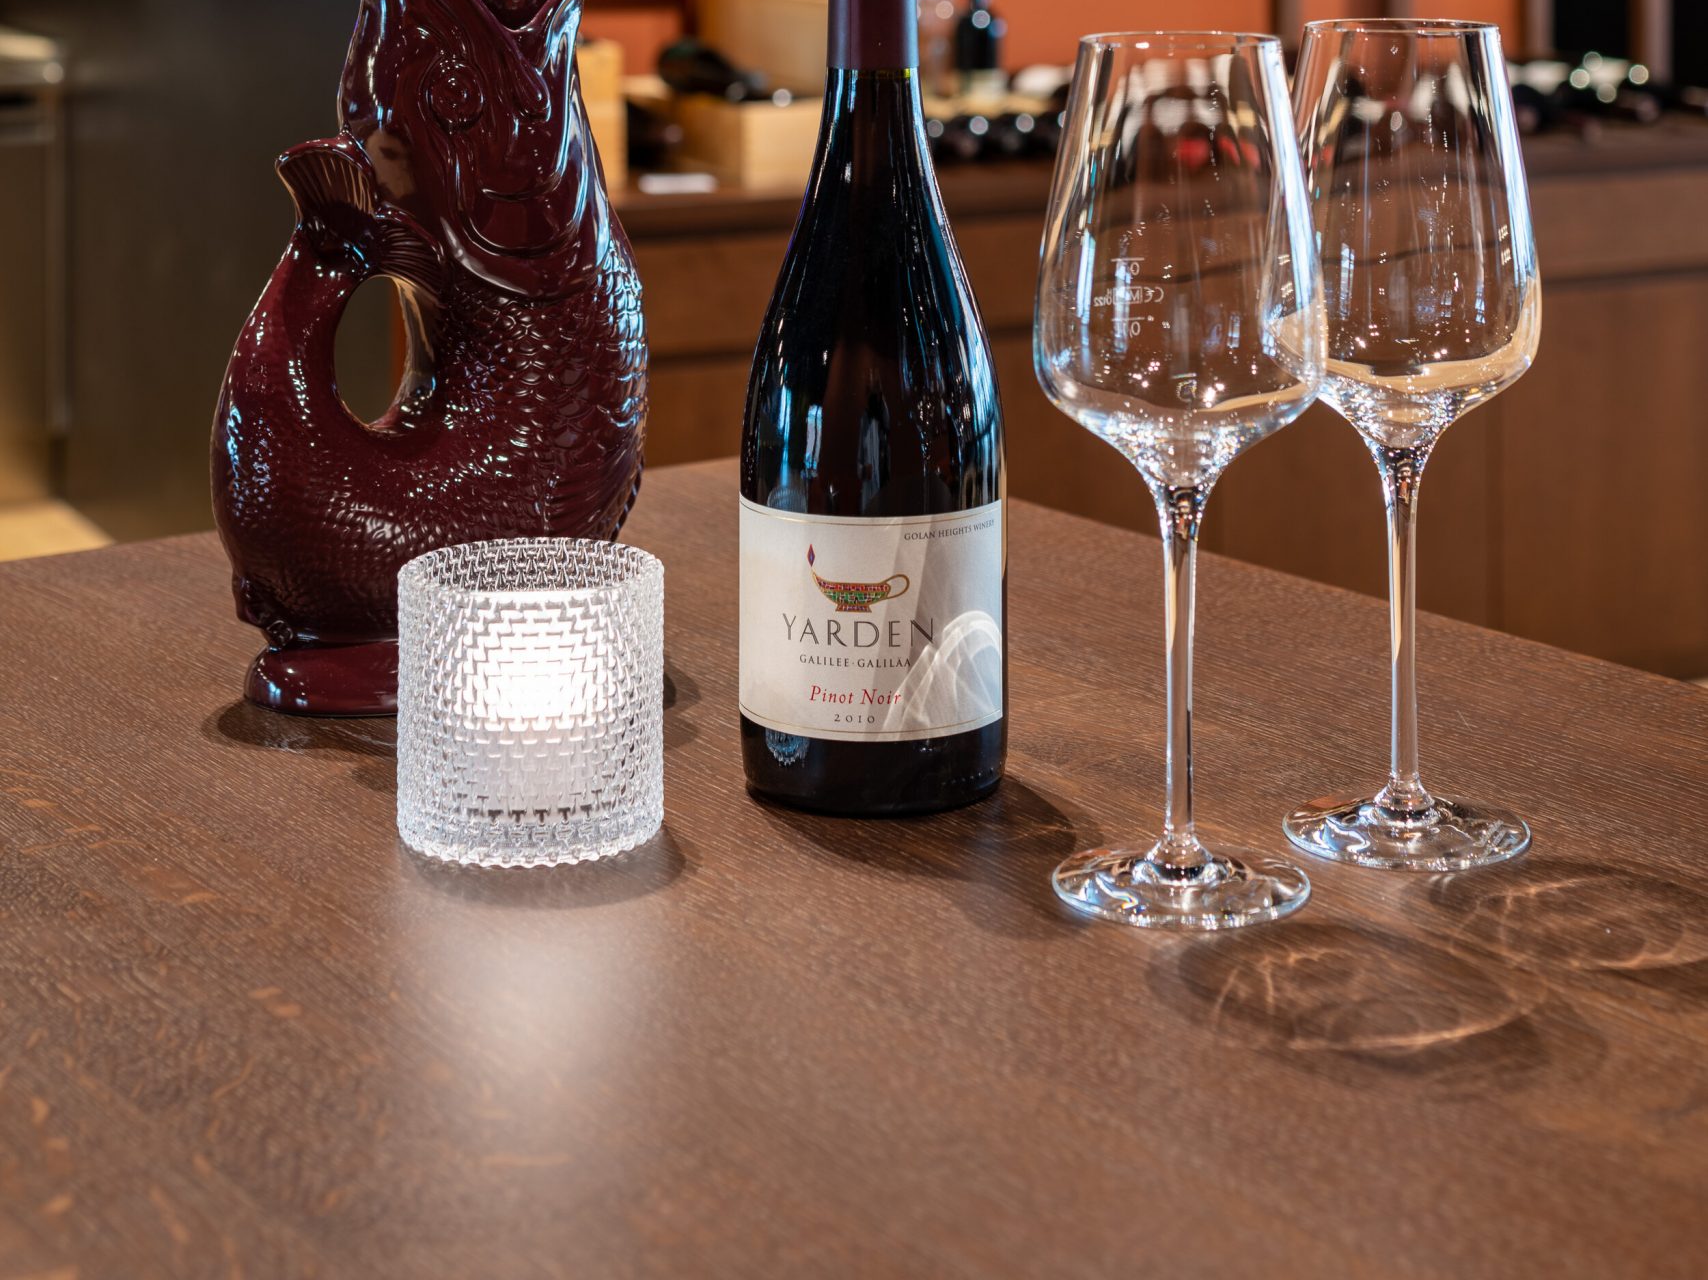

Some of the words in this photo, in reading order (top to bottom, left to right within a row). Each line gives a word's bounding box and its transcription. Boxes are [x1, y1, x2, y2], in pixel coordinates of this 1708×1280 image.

[904, 531, 936, 541] GOLAN
[938, 525, 972, 537] HEIGHTS
[782, 613, 934, 648] YARDEN
[809, 685, 854, 705] Pinot
[860, 688, 902, 705] Noir
[834, 713, 875, 724] 2010
